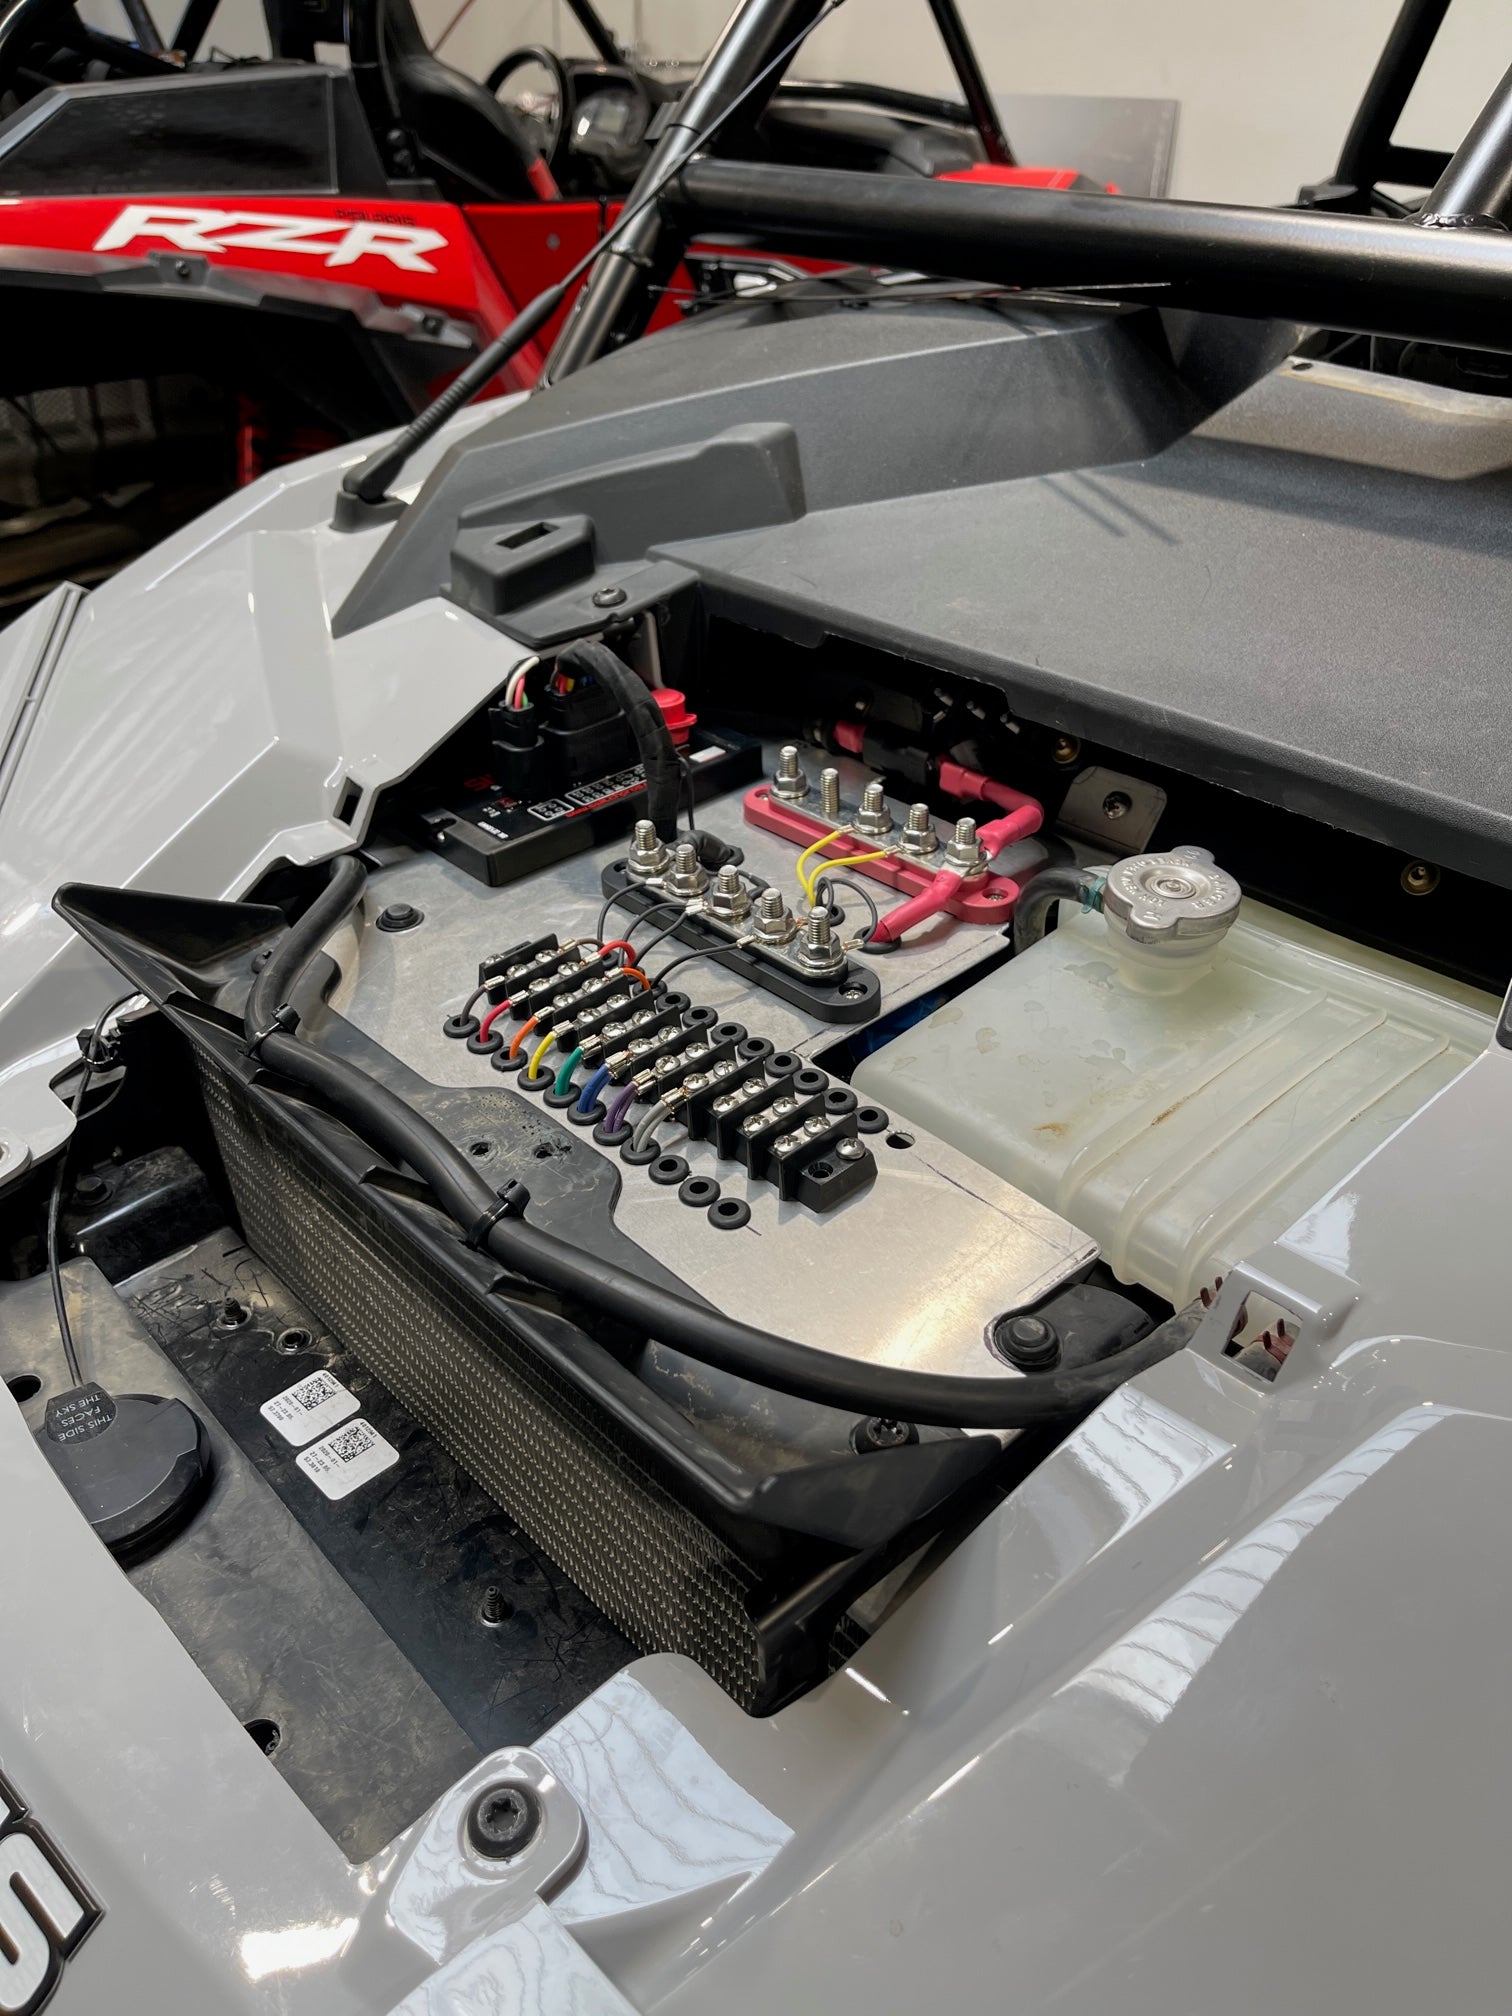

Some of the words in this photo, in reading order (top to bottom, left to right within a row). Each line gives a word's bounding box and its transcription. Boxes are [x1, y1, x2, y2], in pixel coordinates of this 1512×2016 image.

[92, 204, 450, 274] RZR
[78, 1394, 101, 1408] THE
[55, 1403, 76, 1418] SKY
[61, 1406, 101, 1427] FACES
[87, 1414, 112, 1429] THIS
[57, 1425, 85, 1441] SIDE
